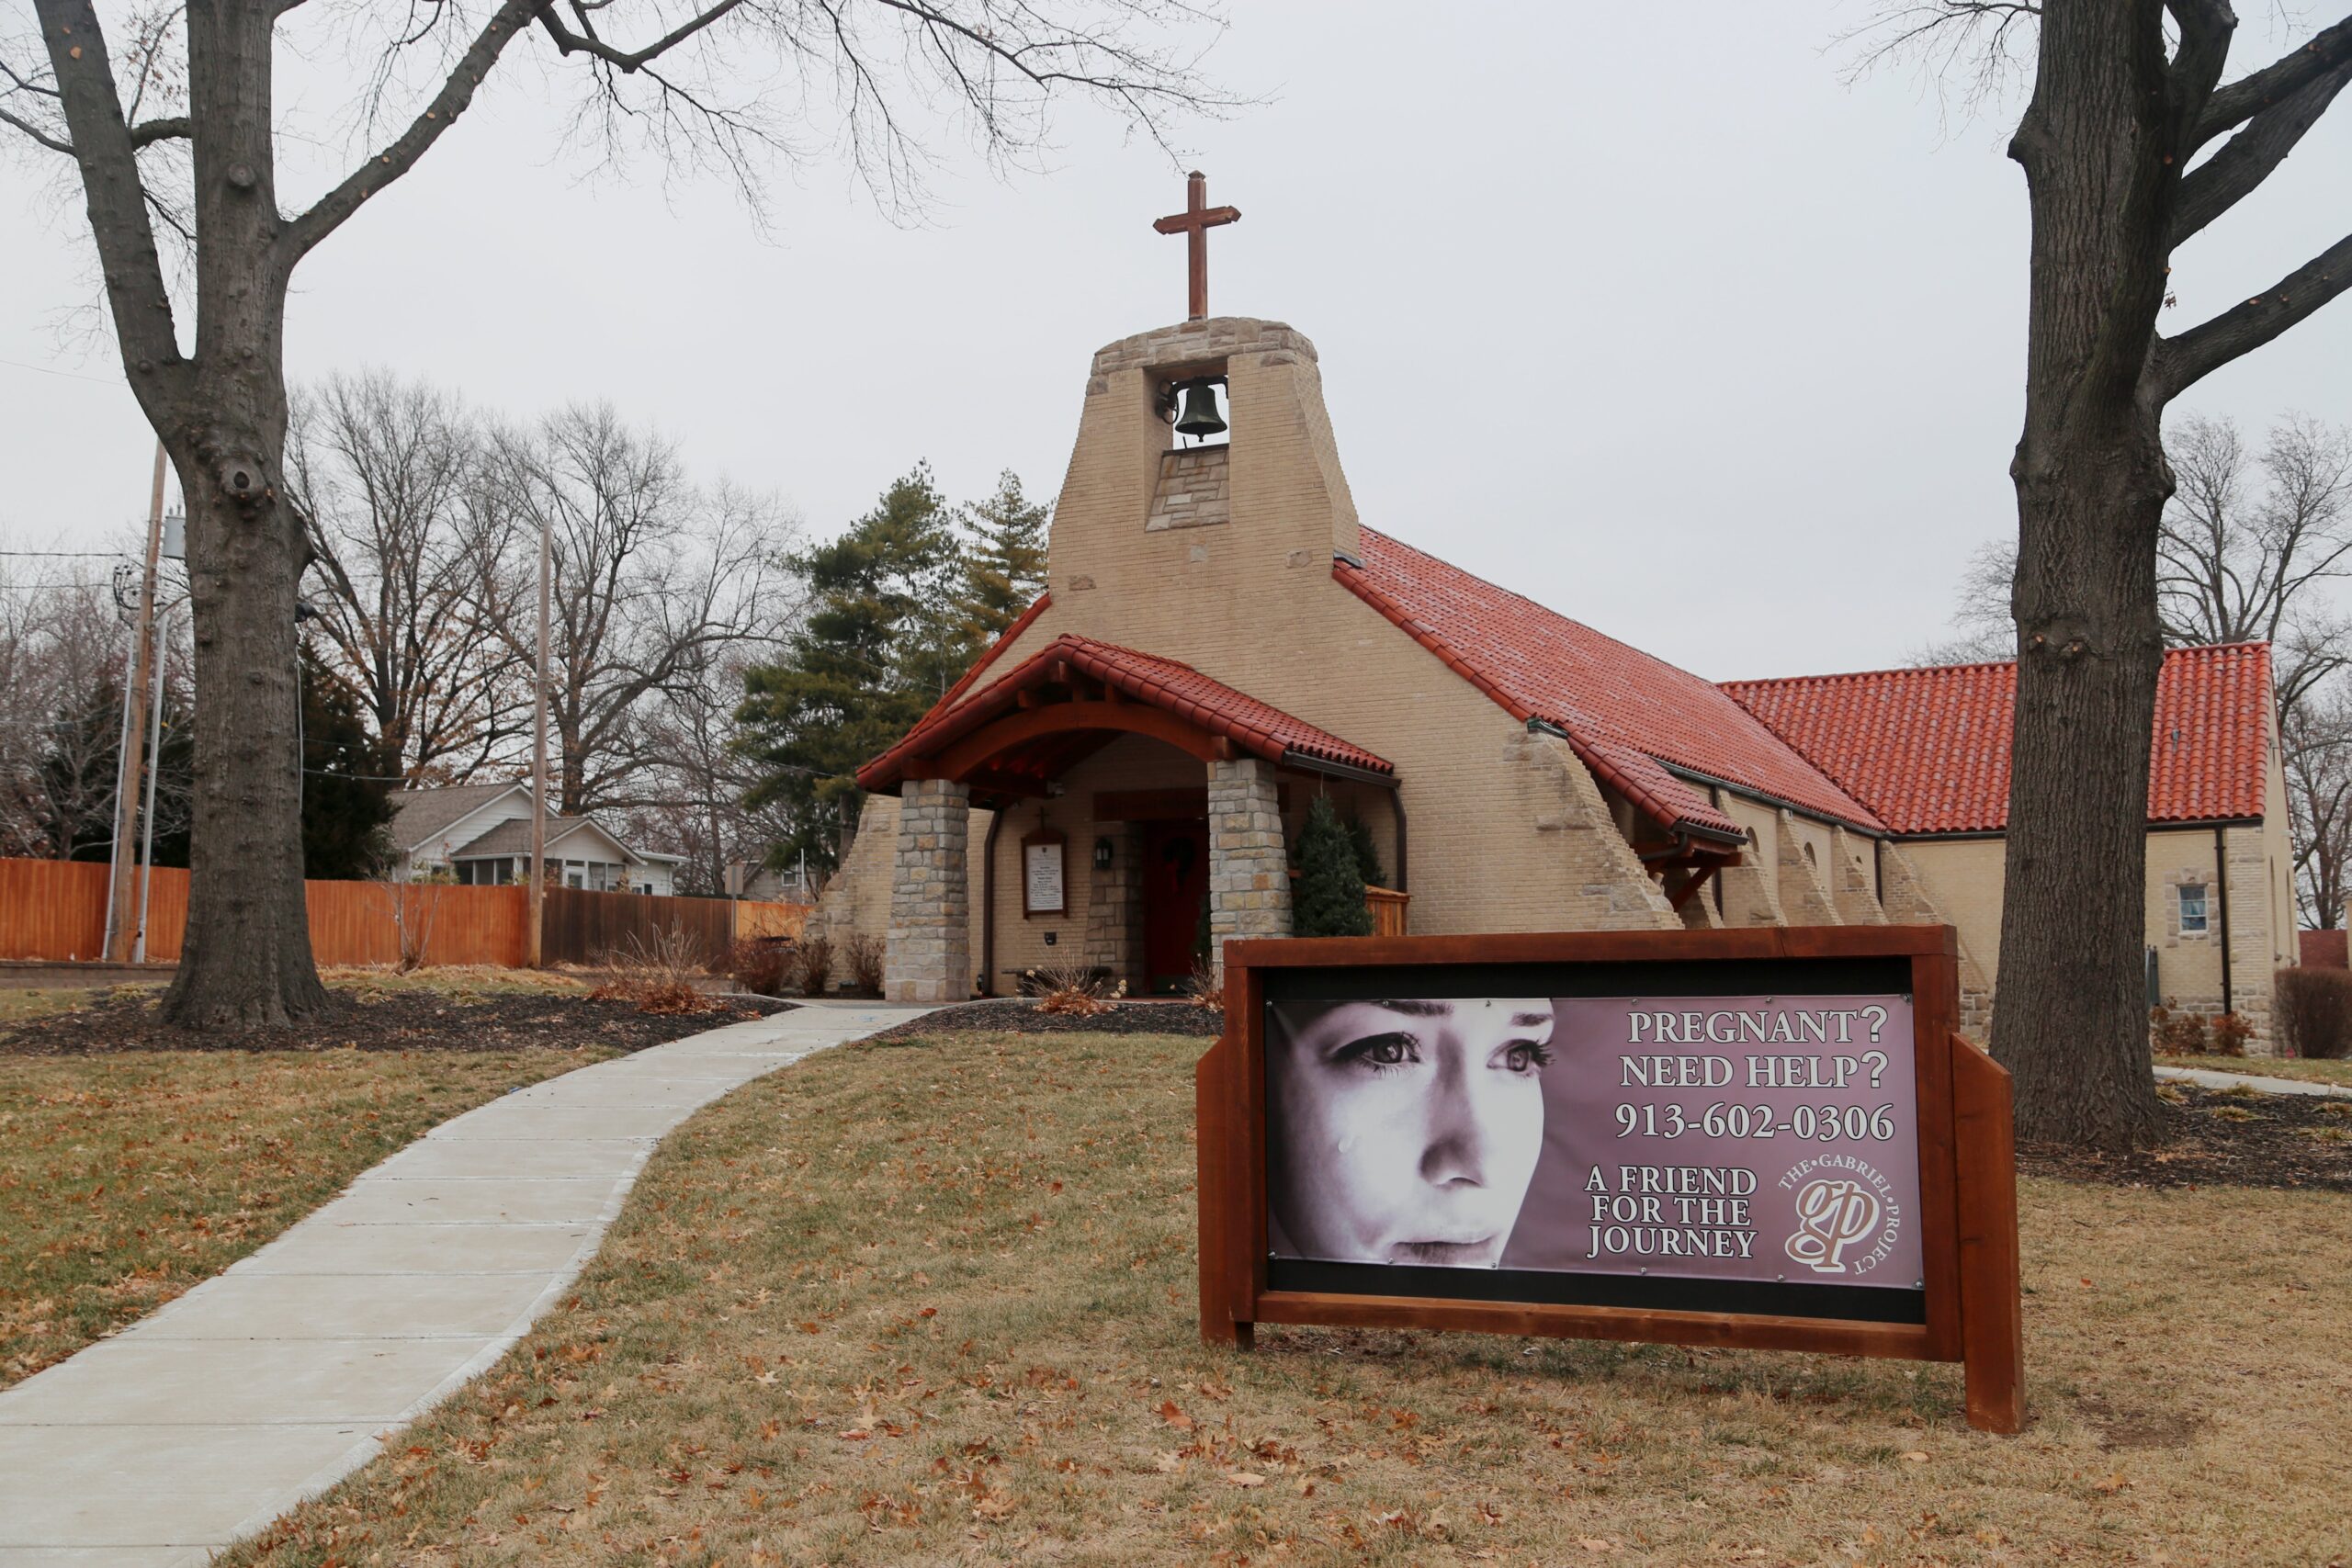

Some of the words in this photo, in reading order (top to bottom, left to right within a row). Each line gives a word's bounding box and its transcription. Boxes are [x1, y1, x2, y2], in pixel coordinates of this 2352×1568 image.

[1627, 1005, 1889, 1043] PREGNANT?
[1619, 1055, 1734, 1088] NEED
[1745, 1050, 1889, 1089] HELP?
[1615, 1101, 1895, 1142] 913-602-0306
[1584, 1164, 1608, 1192] A
[1618, 1165, 1758, 1195] FRIEND
[1591, 1195, 1664, 1224] FOR
[1673, 1197, 1751, 1226] THE
[1587, 1224, 1758, 1258] JOURNEY
